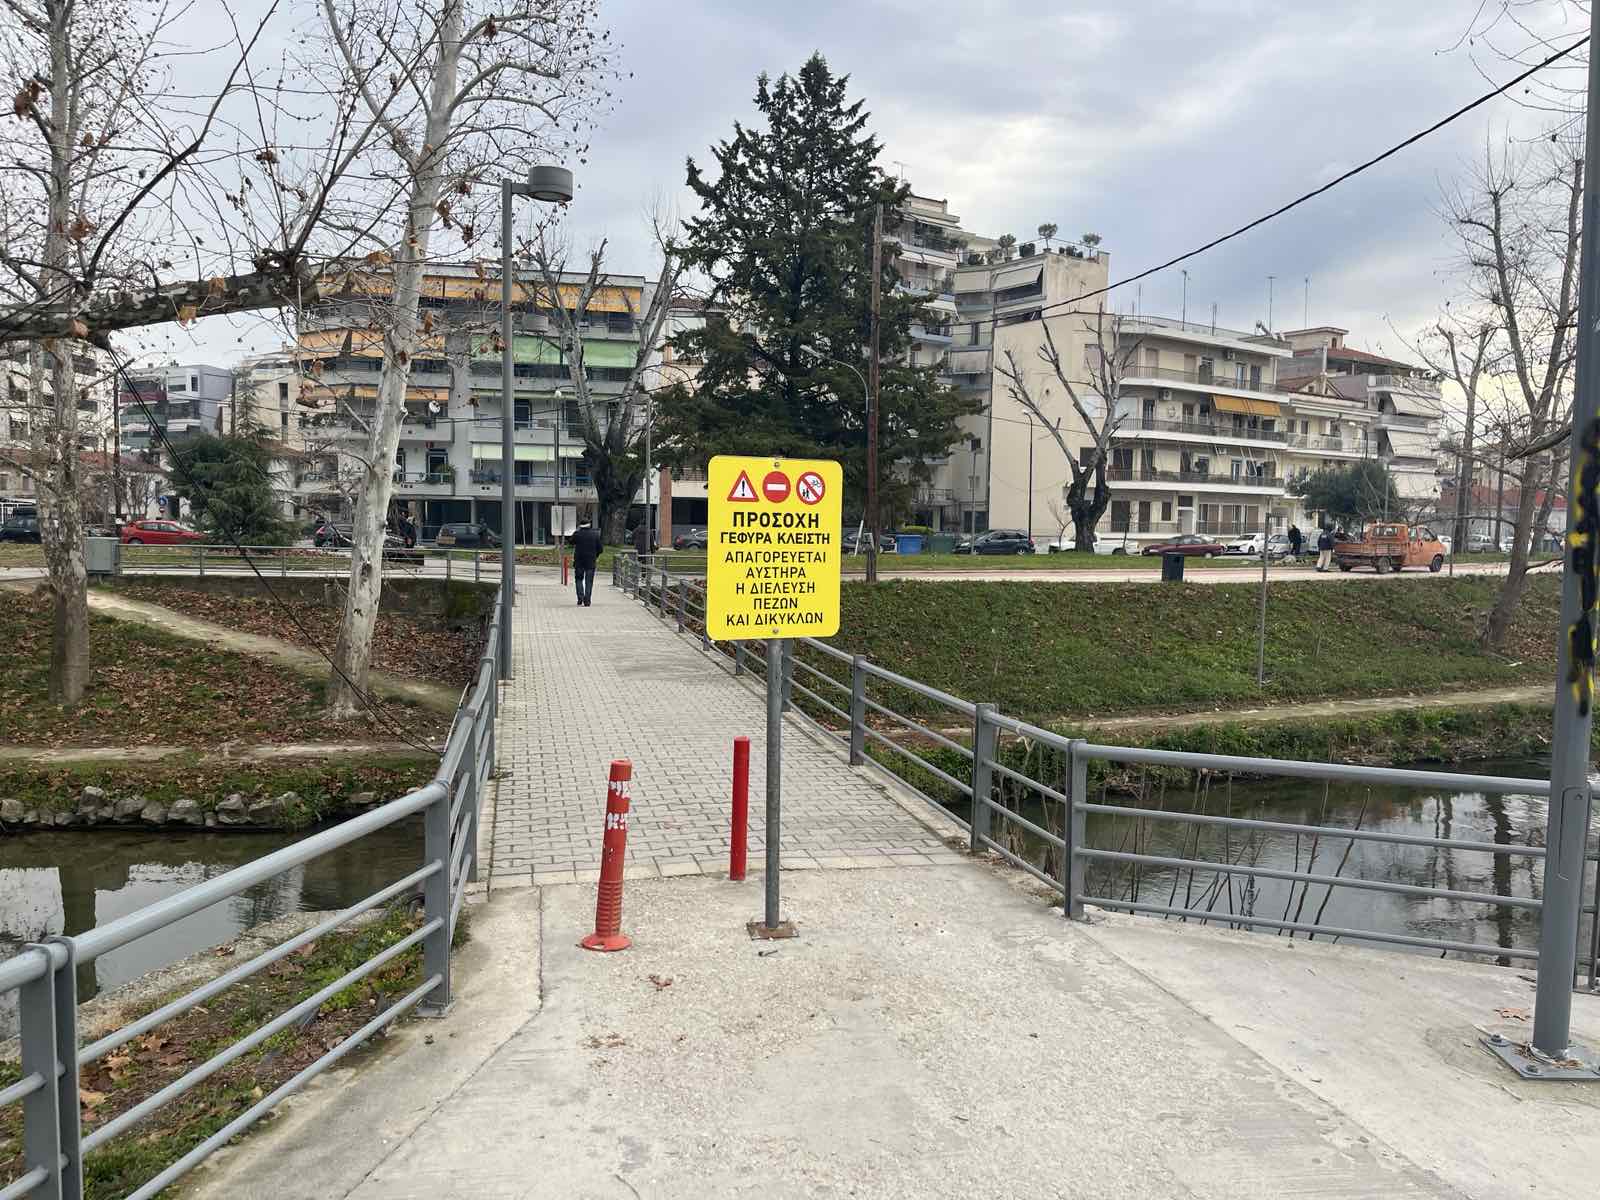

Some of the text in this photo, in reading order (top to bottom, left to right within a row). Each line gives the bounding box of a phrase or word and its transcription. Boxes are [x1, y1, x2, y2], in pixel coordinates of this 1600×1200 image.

[733, 512, 819, 528] ΠΡΟΣΟΧΗ
[721, 532, 829, 544] ΓΕΦΥΡΑ ΚΛΕΙΣΤΗ
[725, 552, 826, 563] ΑΠΑΓΟΡΕΥΕΤΑΙ
[746, 567, 806, 578] ΑΥΣΤΗΡΑ
[736, 582, 815, 594] Η ΔΙΕΛΕΥΣΗ
[754, 598, 798, 609] ΠΕΖΩΝ
[726, 613, 823, 626] ΚΑΙ ΔΙΚΥΚΛΩΝ
